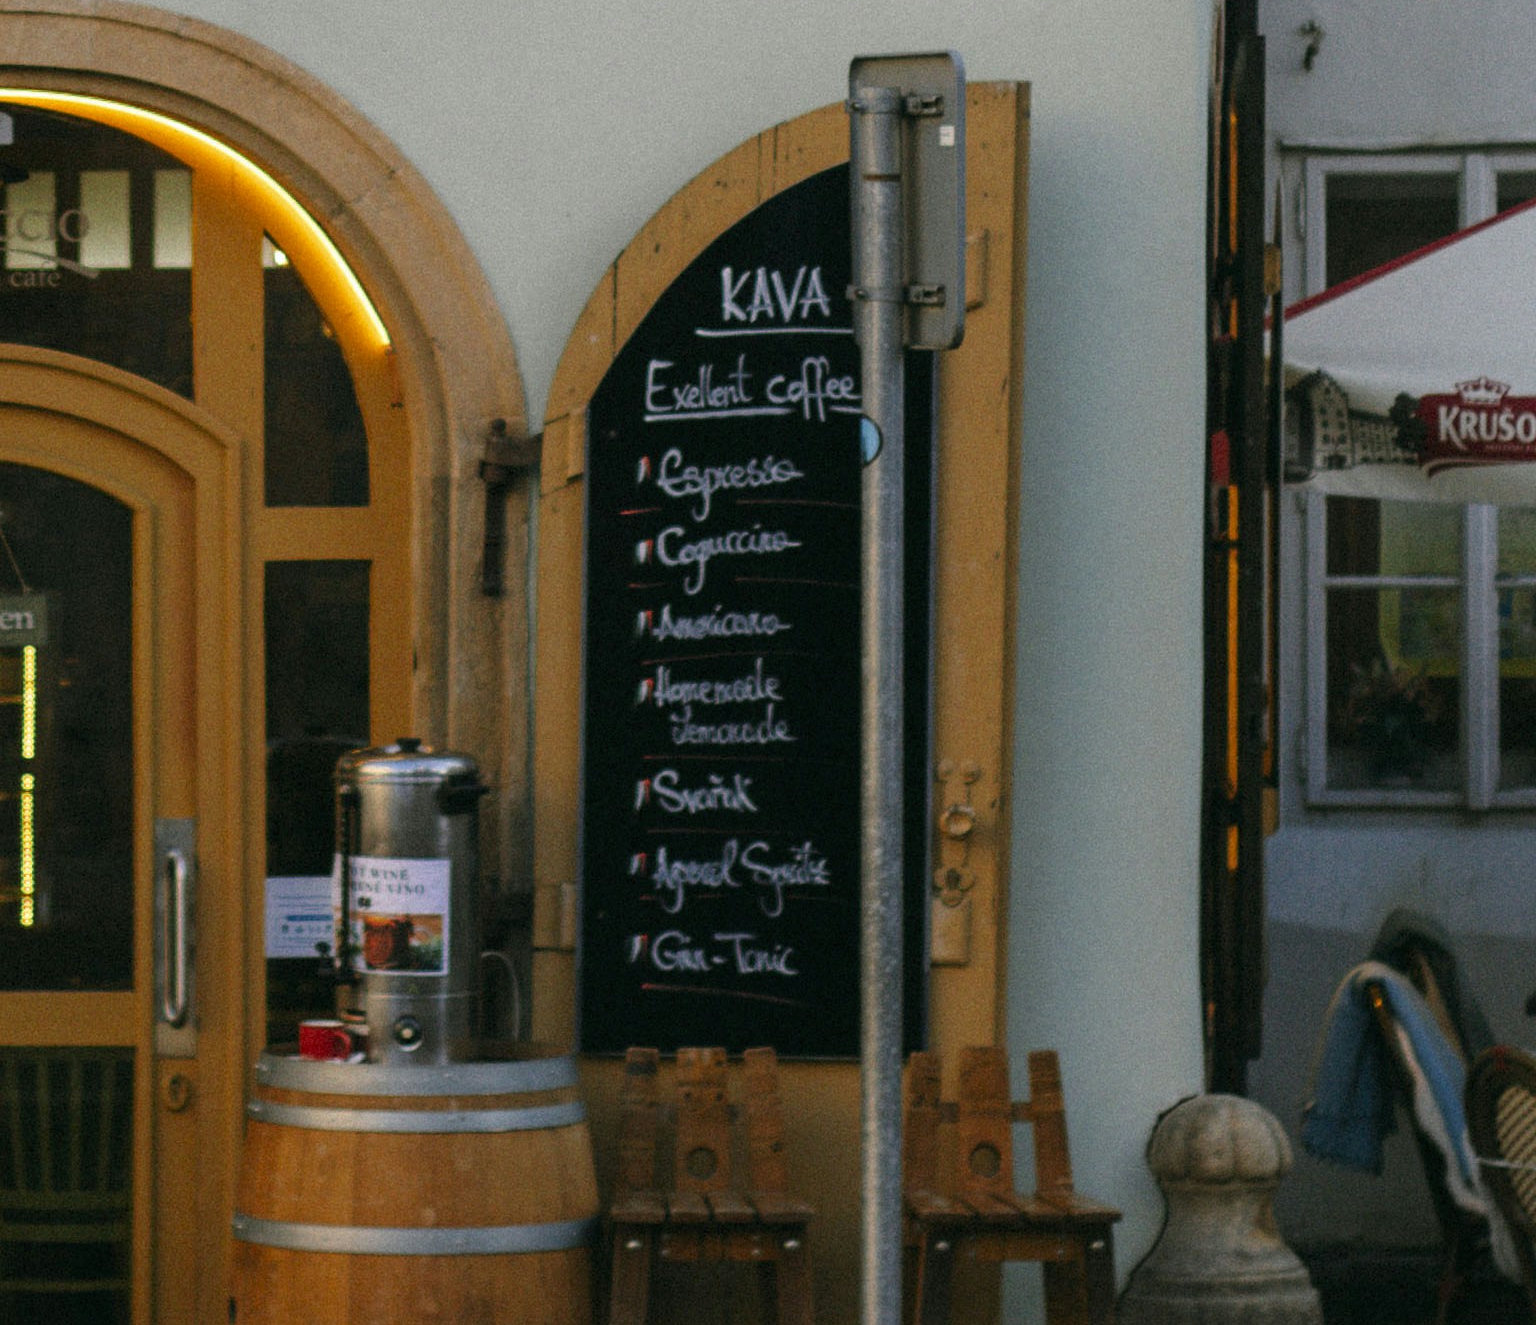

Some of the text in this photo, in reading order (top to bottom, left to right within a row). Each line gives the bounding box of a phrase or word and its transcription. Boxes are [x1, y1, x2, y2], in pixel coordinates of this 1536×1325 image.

[721, 265, 830, 323] KAVA
[645, 354, 862, 422] Exellent coffee
[1438, 404, 1536, 451] KRUŠO
[656, 448, 804, 522] Espresso
[652, 604, 792, 642] Americano
